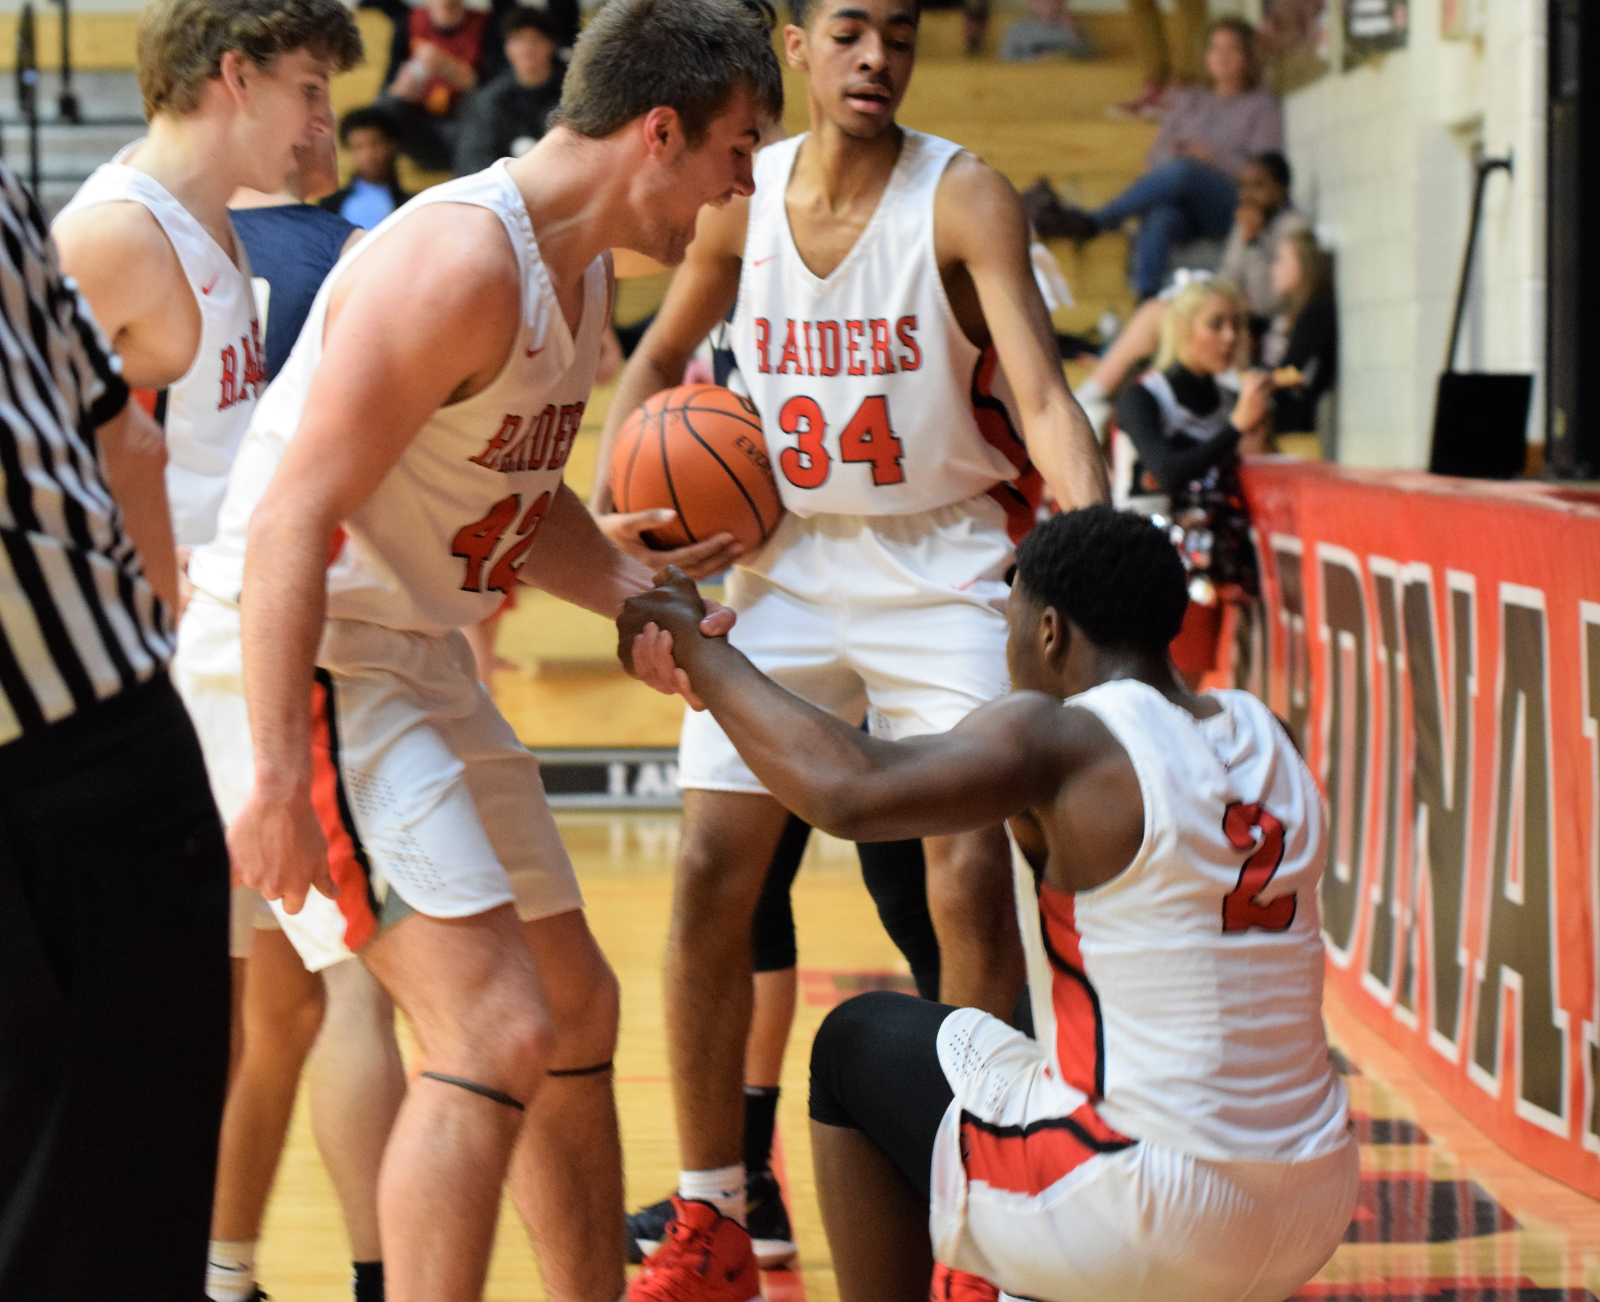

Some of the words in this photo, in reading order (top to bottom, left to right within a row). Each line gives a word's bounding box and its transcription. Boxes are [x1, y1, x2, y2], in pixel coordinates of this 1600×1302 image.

[754, 315, 922, 377] RAIDERS
[779, 394, 904, 489] 34
[451, 491, 551, 595] 42
[1221, 800, 1298, 934] 2
